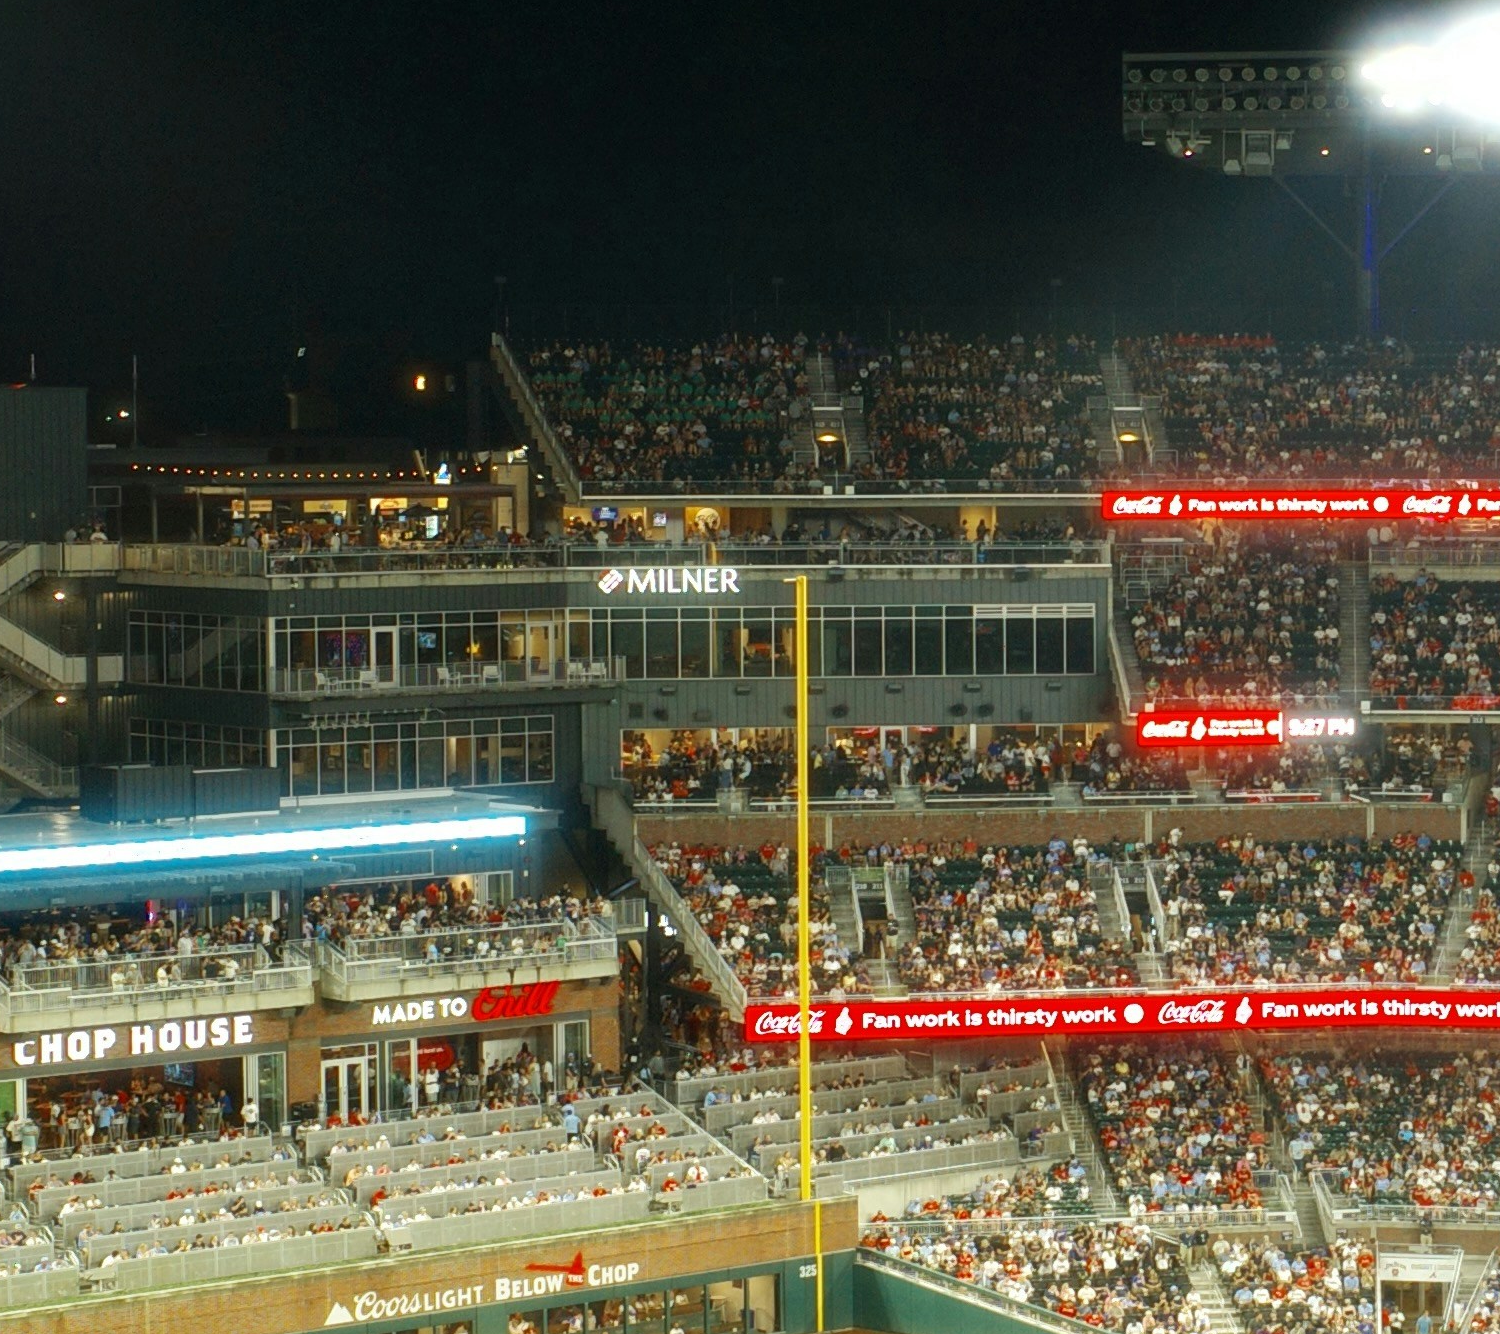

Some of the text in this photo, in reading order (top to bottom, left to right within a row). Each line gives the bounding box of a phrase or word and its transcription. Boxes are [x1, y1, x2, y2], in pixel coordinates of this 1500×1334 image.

[628, 569, 740, 593] MILNER
[1328, 718, 1354, 736] PM
[372, 980, 560, 1024] MADE TO Chill
[1156, 999, 1226, 1025] Coca-Cola
[1263, 1003, 1298, 1017] Fan
[1303, 1000, 1356, 1016] work
[1362, 999, 1378, 1015] is
[1382, 999, 1451, 1019] thirsty
[12, 1015, 253, 1066] CHOP HOUSE
[799, 1265, 817, 1279] 325
[354, 1286, 483, 1321] Coors LIGHT
